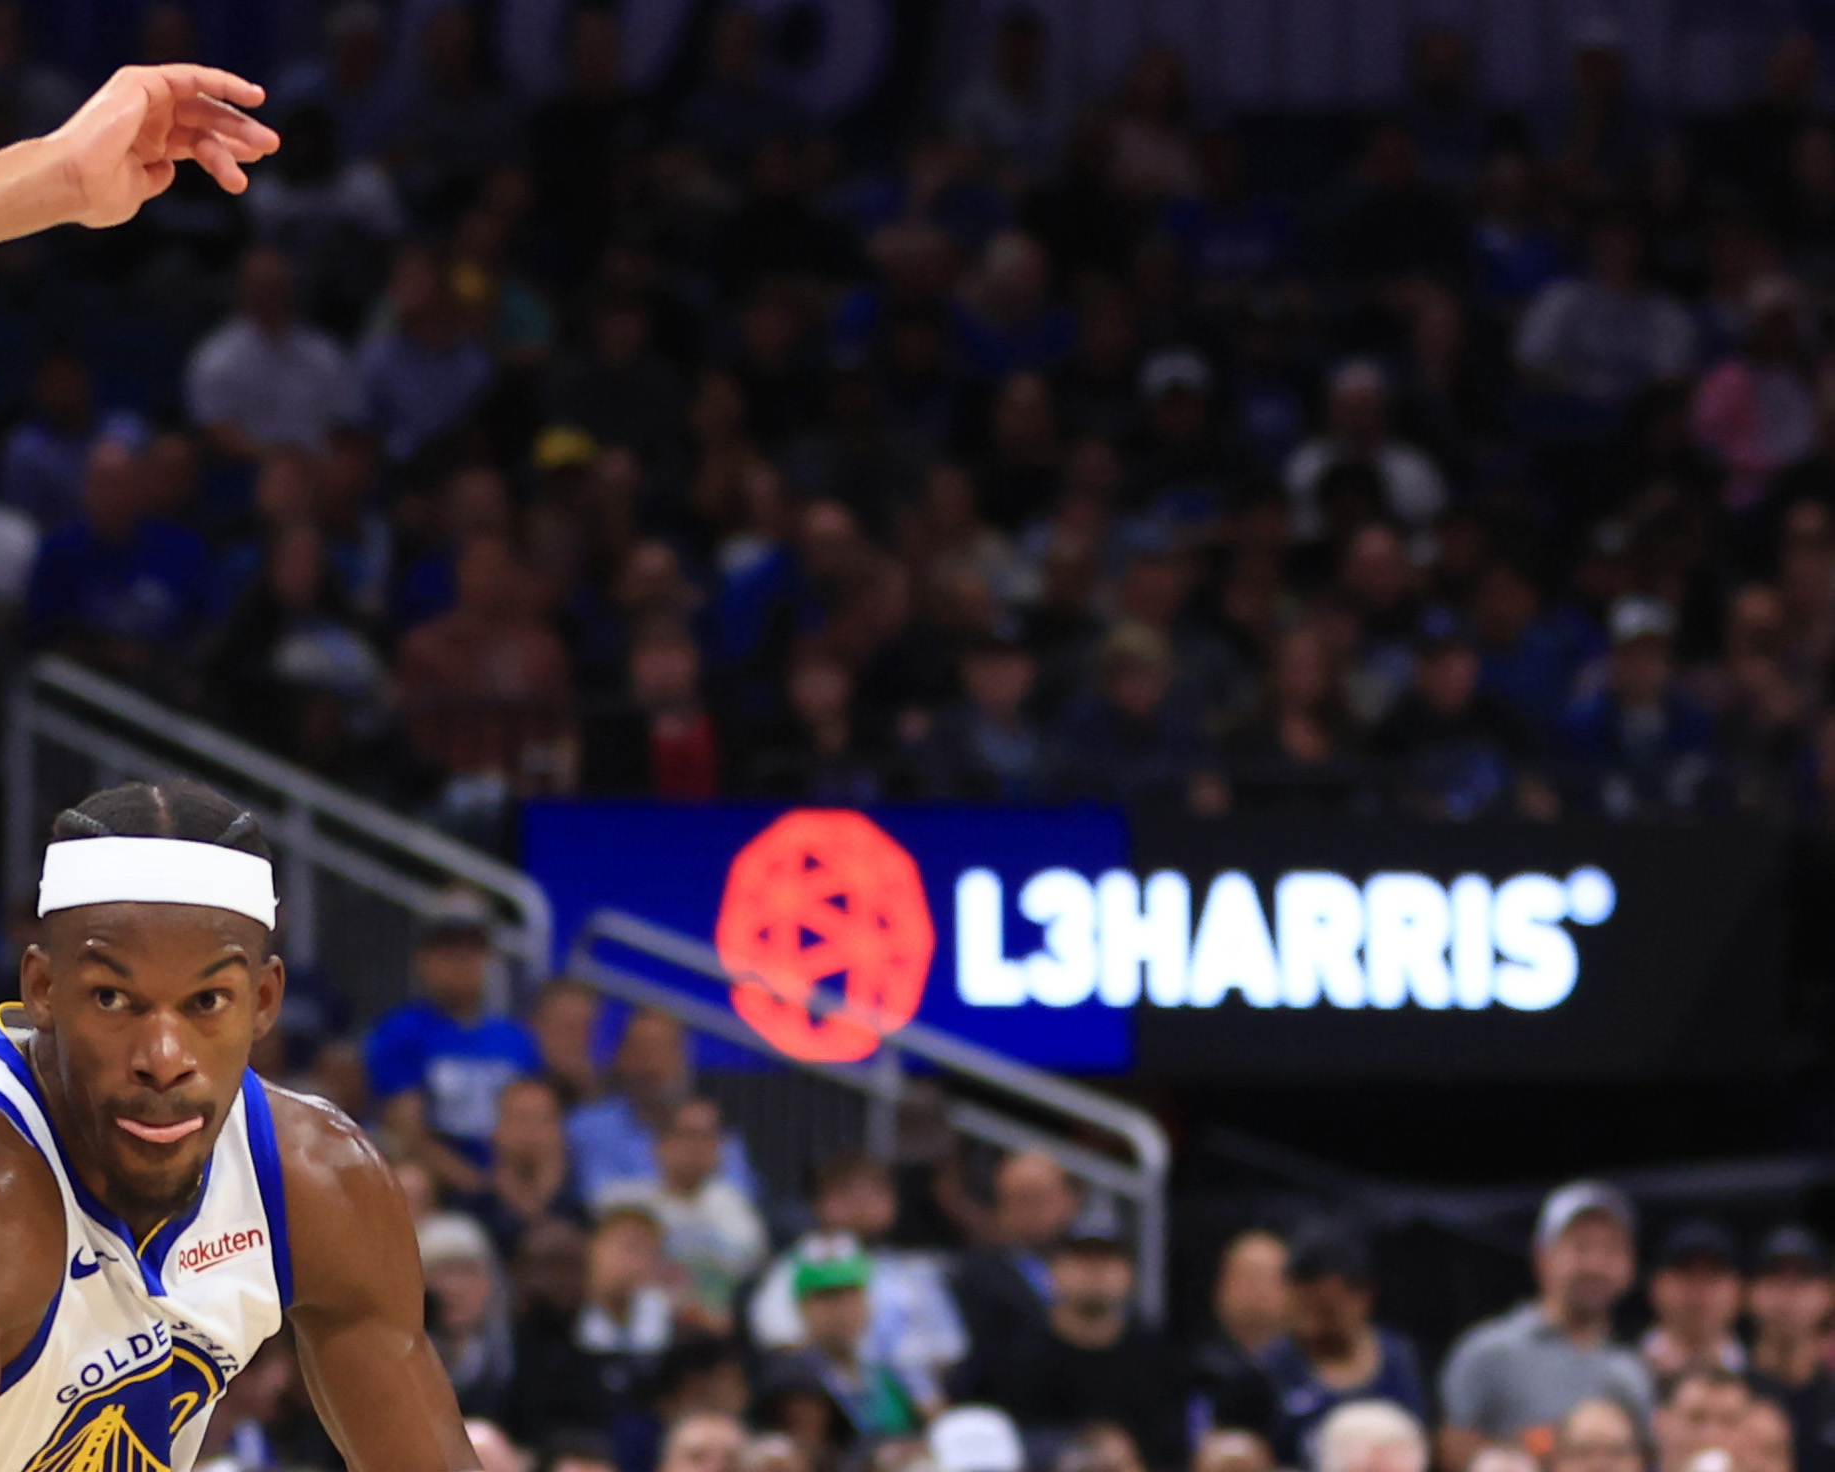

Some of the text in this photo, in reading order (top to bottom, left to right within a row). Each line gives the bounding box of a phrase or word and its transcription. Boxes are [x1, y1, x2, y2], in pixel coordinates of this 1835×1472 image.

[955, 866, 1581, 1010] L3HARRIS
[179, 1228, 264, 1273] Rakuten
[57, 1319, 169, 1404] GOLDE
